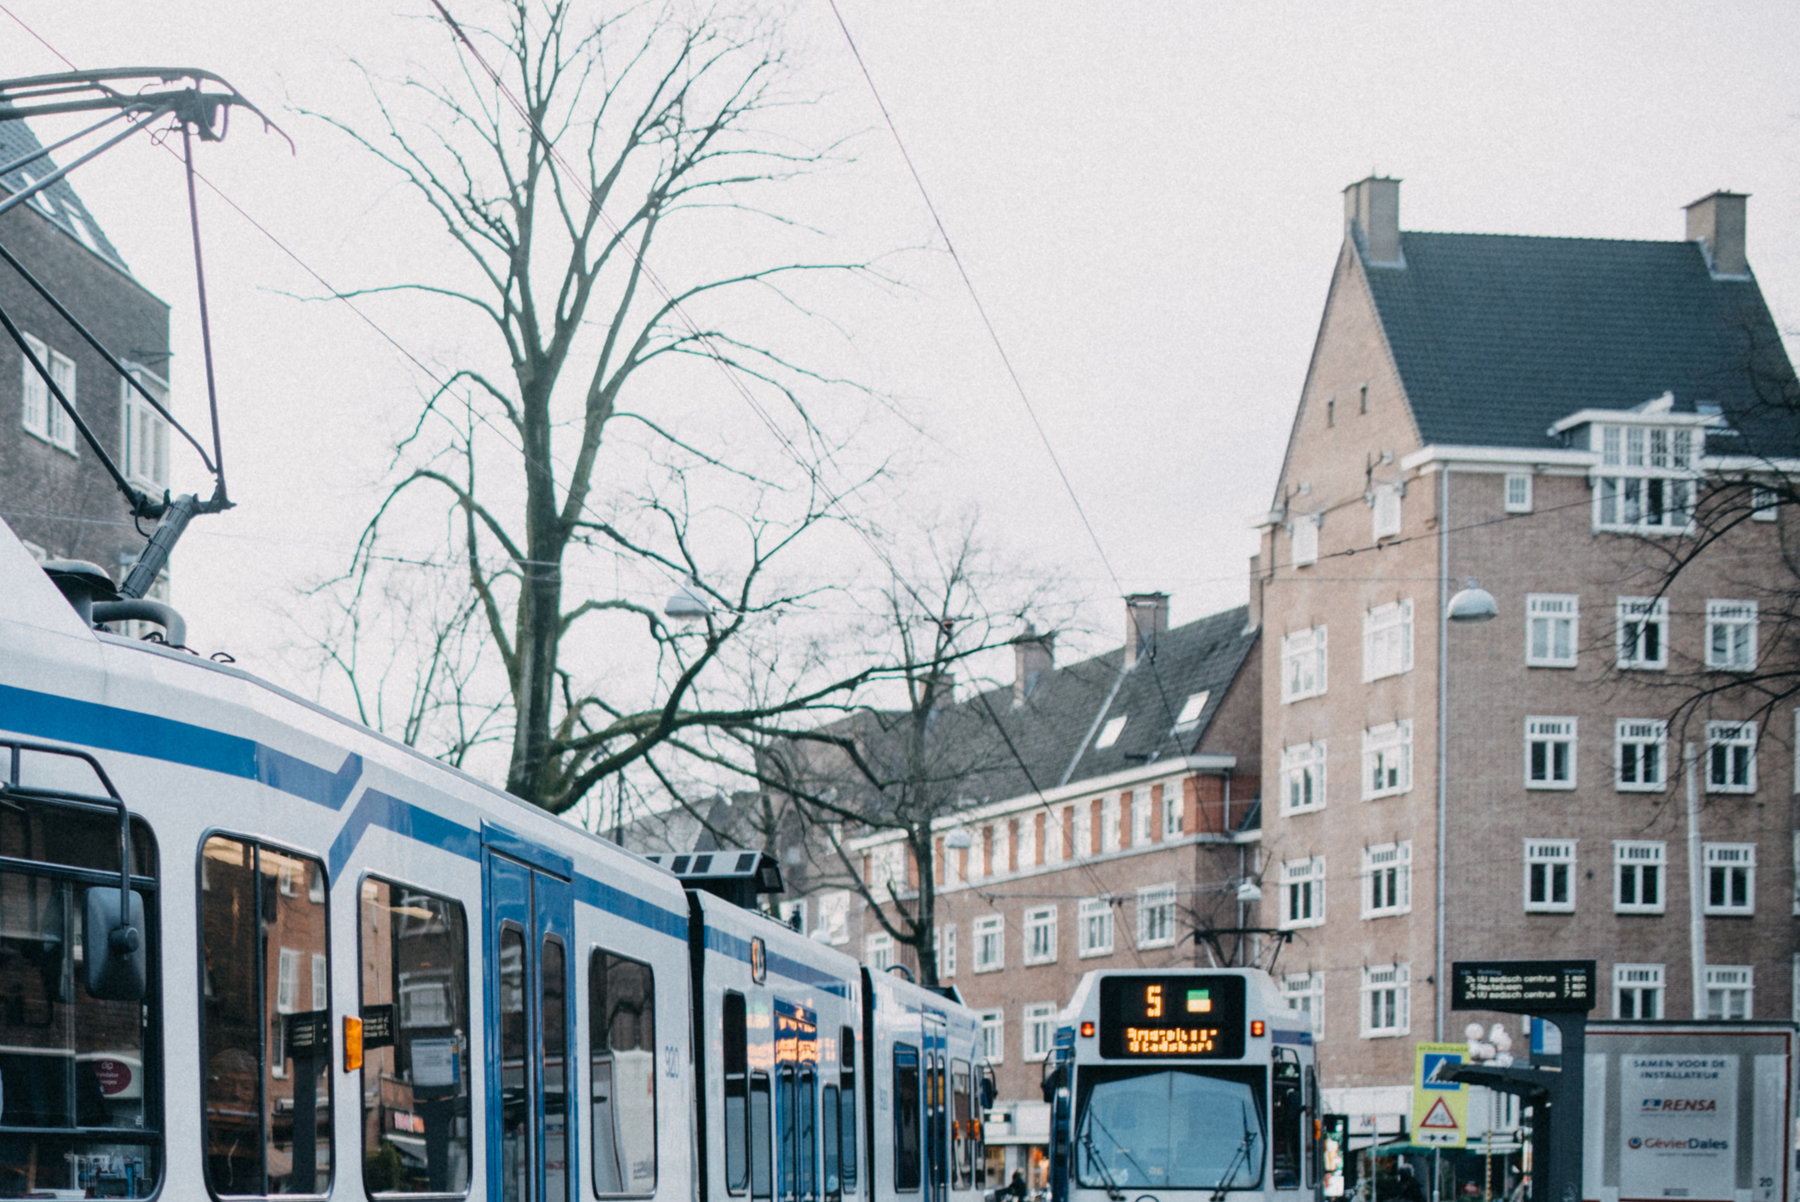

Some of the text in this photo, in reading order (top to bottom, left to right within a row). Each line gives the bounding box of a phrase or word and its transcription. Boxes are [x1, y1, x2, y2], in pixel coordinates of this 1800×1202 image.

[1146, 985, 1162, 1017] 5
[1634, 1060, 1725, 1068] SAMEN VOOR DE
[1640, 1071, 1719, 1079] INSTALLATEUR
[1662, 1100, 1717, 1111] RENSA
